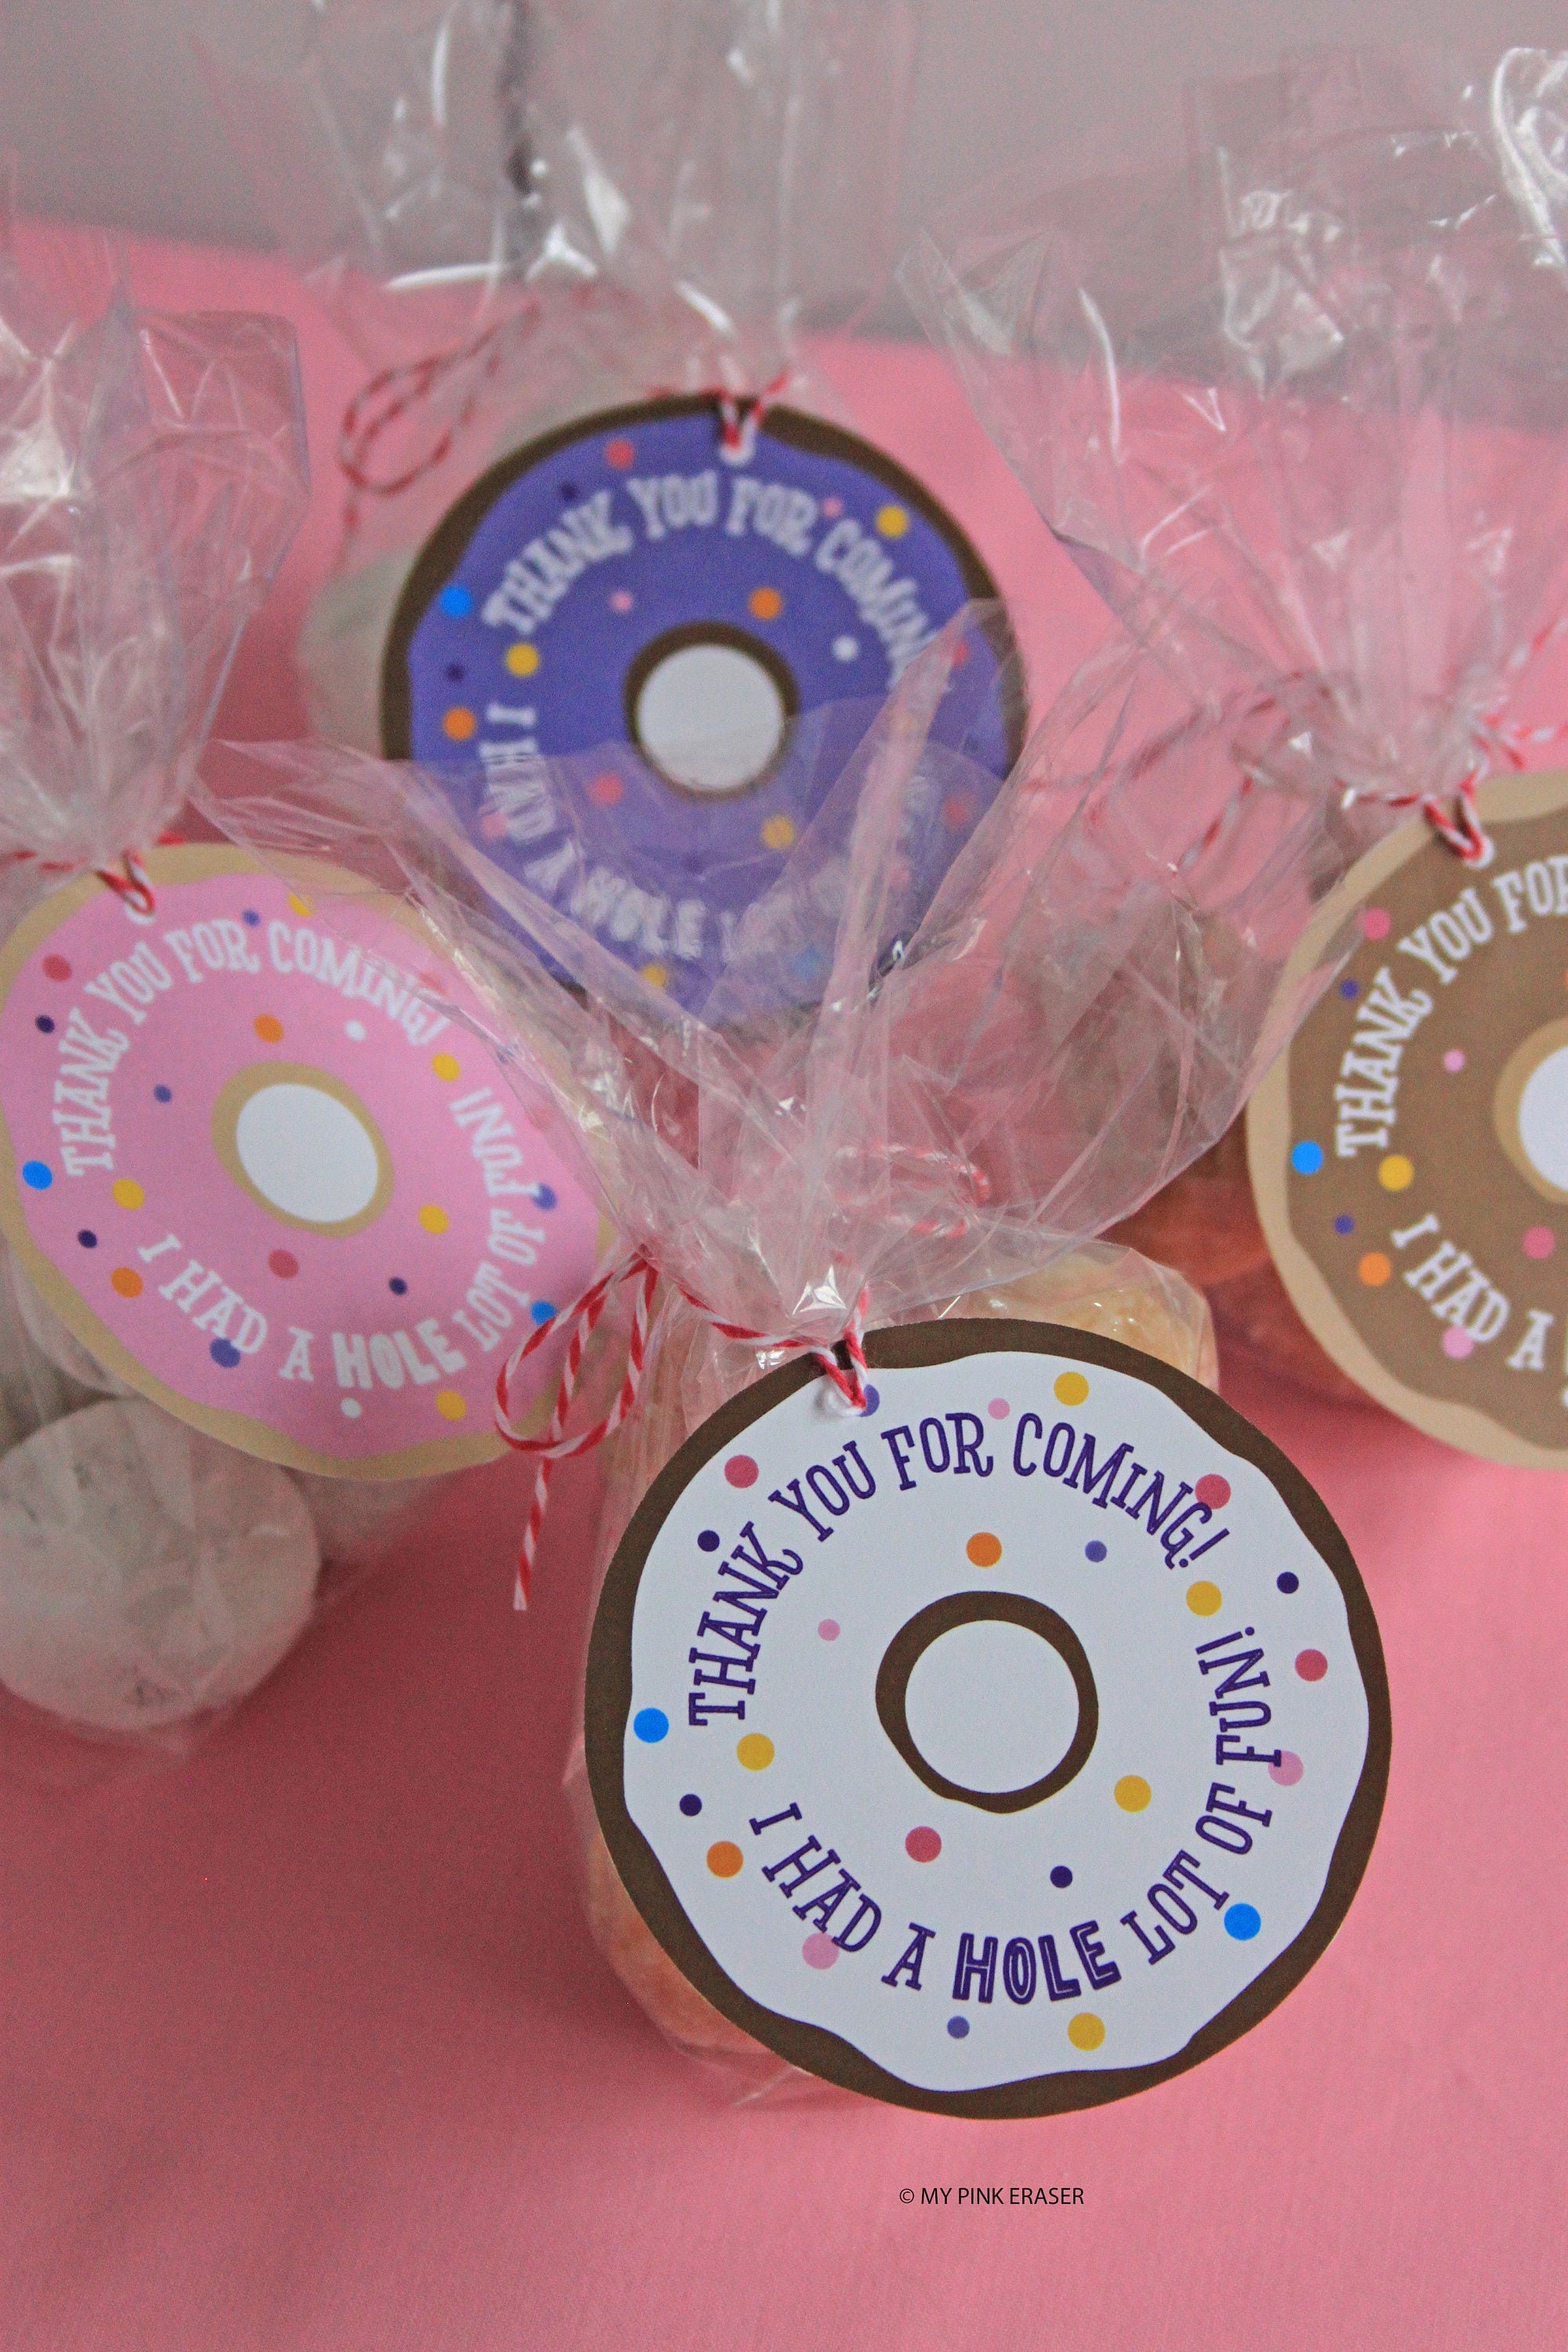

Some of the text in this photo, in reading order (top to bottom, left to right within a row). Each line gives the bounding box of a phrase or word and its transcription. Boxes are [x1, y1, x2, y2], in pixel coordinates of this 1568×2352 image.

[481, 488, 634, 636] THANK
[627, 470, 718, 541] YOU
[726, 474, 818, 557] FOR
[486, 702, 537, 728] I
[479, 738, 557, 844] HAD
[84, 942, 172, 1025] YOU
[163, 918, 261, 983] FOR
[1334, 966, 1434, 1158] THANK
[1396, 887, 1493, 985] YOU
[53, 1006, 130, 1178] THANK
[137, 1233, 181, 1264] I
[487, 1208, 546, 1266] OF
[1391, 1214, 1440, 1249] I
[158, 1259, 268, 1354] HAD
[452, 1261, 530, 1352] LOT
[1403, 1241, 1510, 1343] HAD
[278, 1326, 314, 1382] A
[332, 1319, 467, 1390] HOLE
[1505, 1308, 1555, 1370] A
[688, 1412, 1230, 1726] THANK YOU FOR COMING!
[749, 1626, 1282, 2005] I HAD A HOLE LOT OF FUN!
